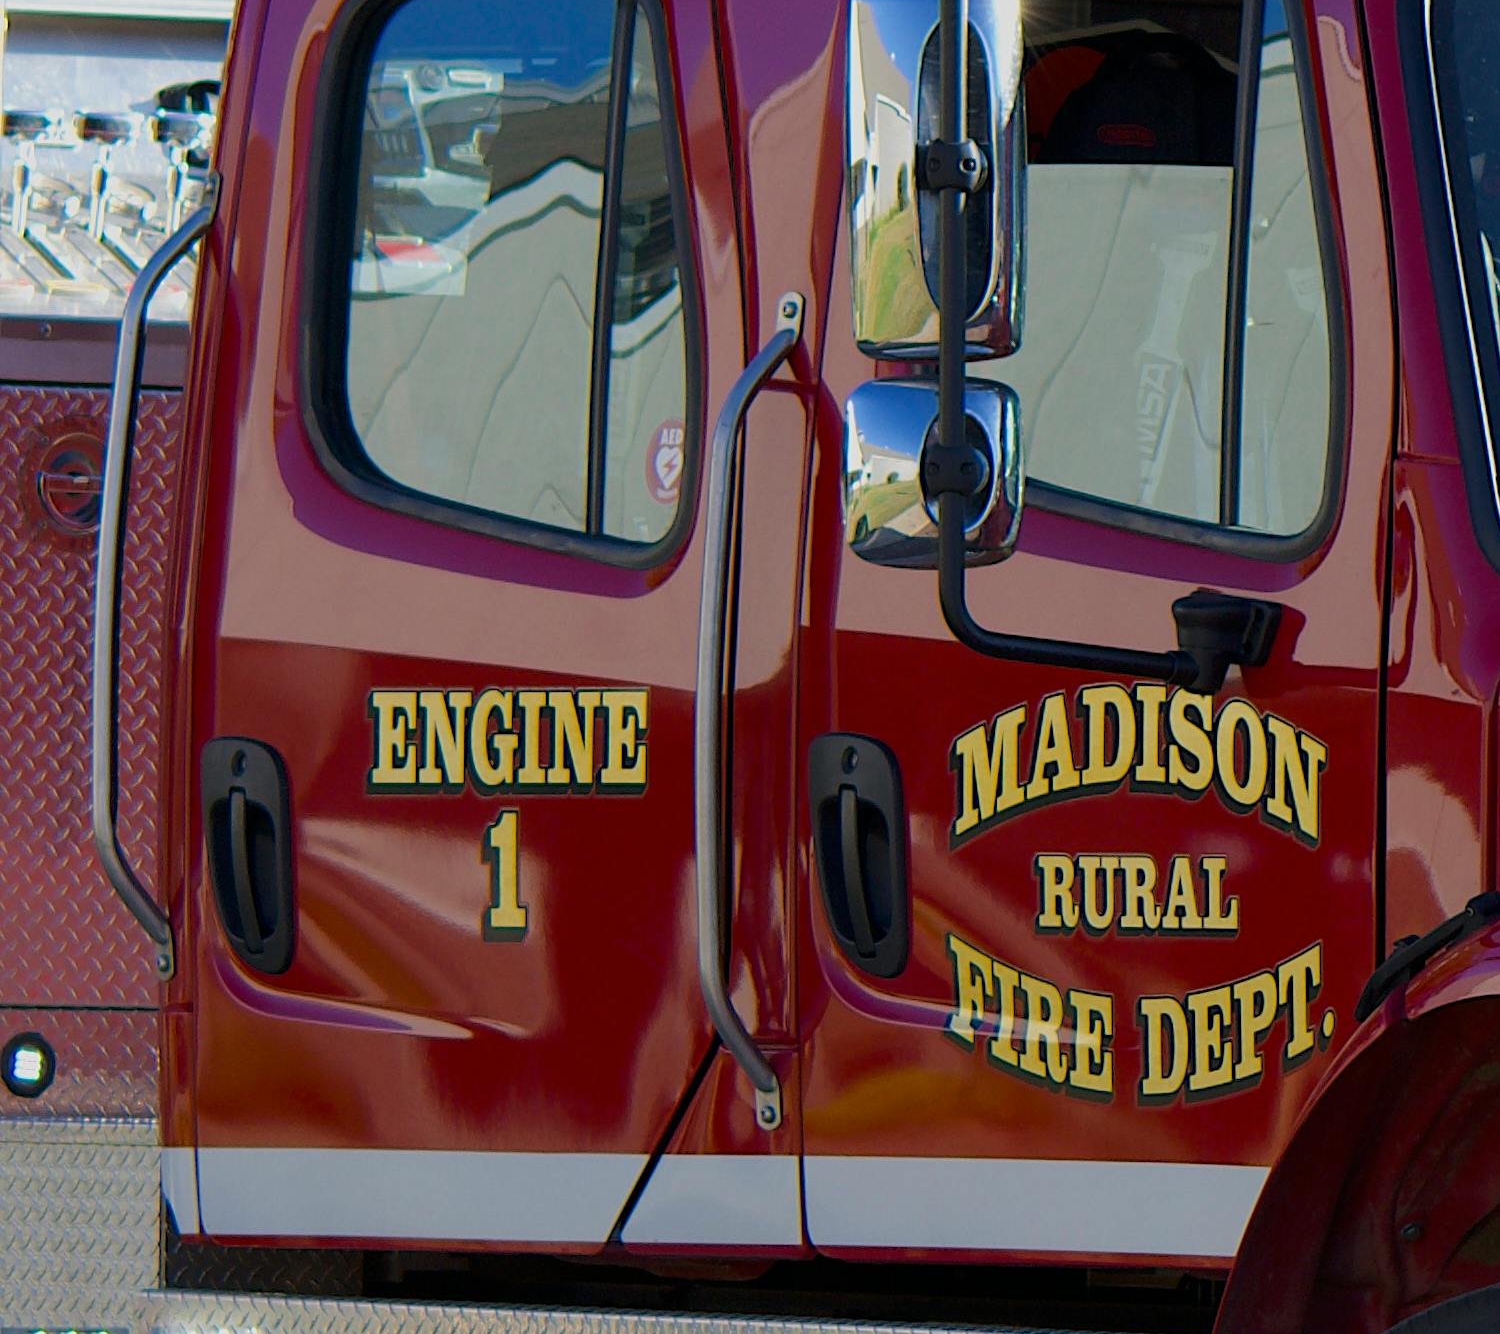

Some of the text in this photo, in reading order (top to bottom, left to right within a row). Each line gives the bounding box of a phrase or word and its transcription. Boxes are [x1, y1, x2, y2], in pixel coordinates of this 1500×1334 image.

[367, 688, 649, 794] ENGINE
[951, 683, 1328, 848] MADISON
[485, 809, 529, 940] 1
[1035, 854, 1240, 934] RURAL
[944, 934, 1337, 1104] FIRE DEPT.
